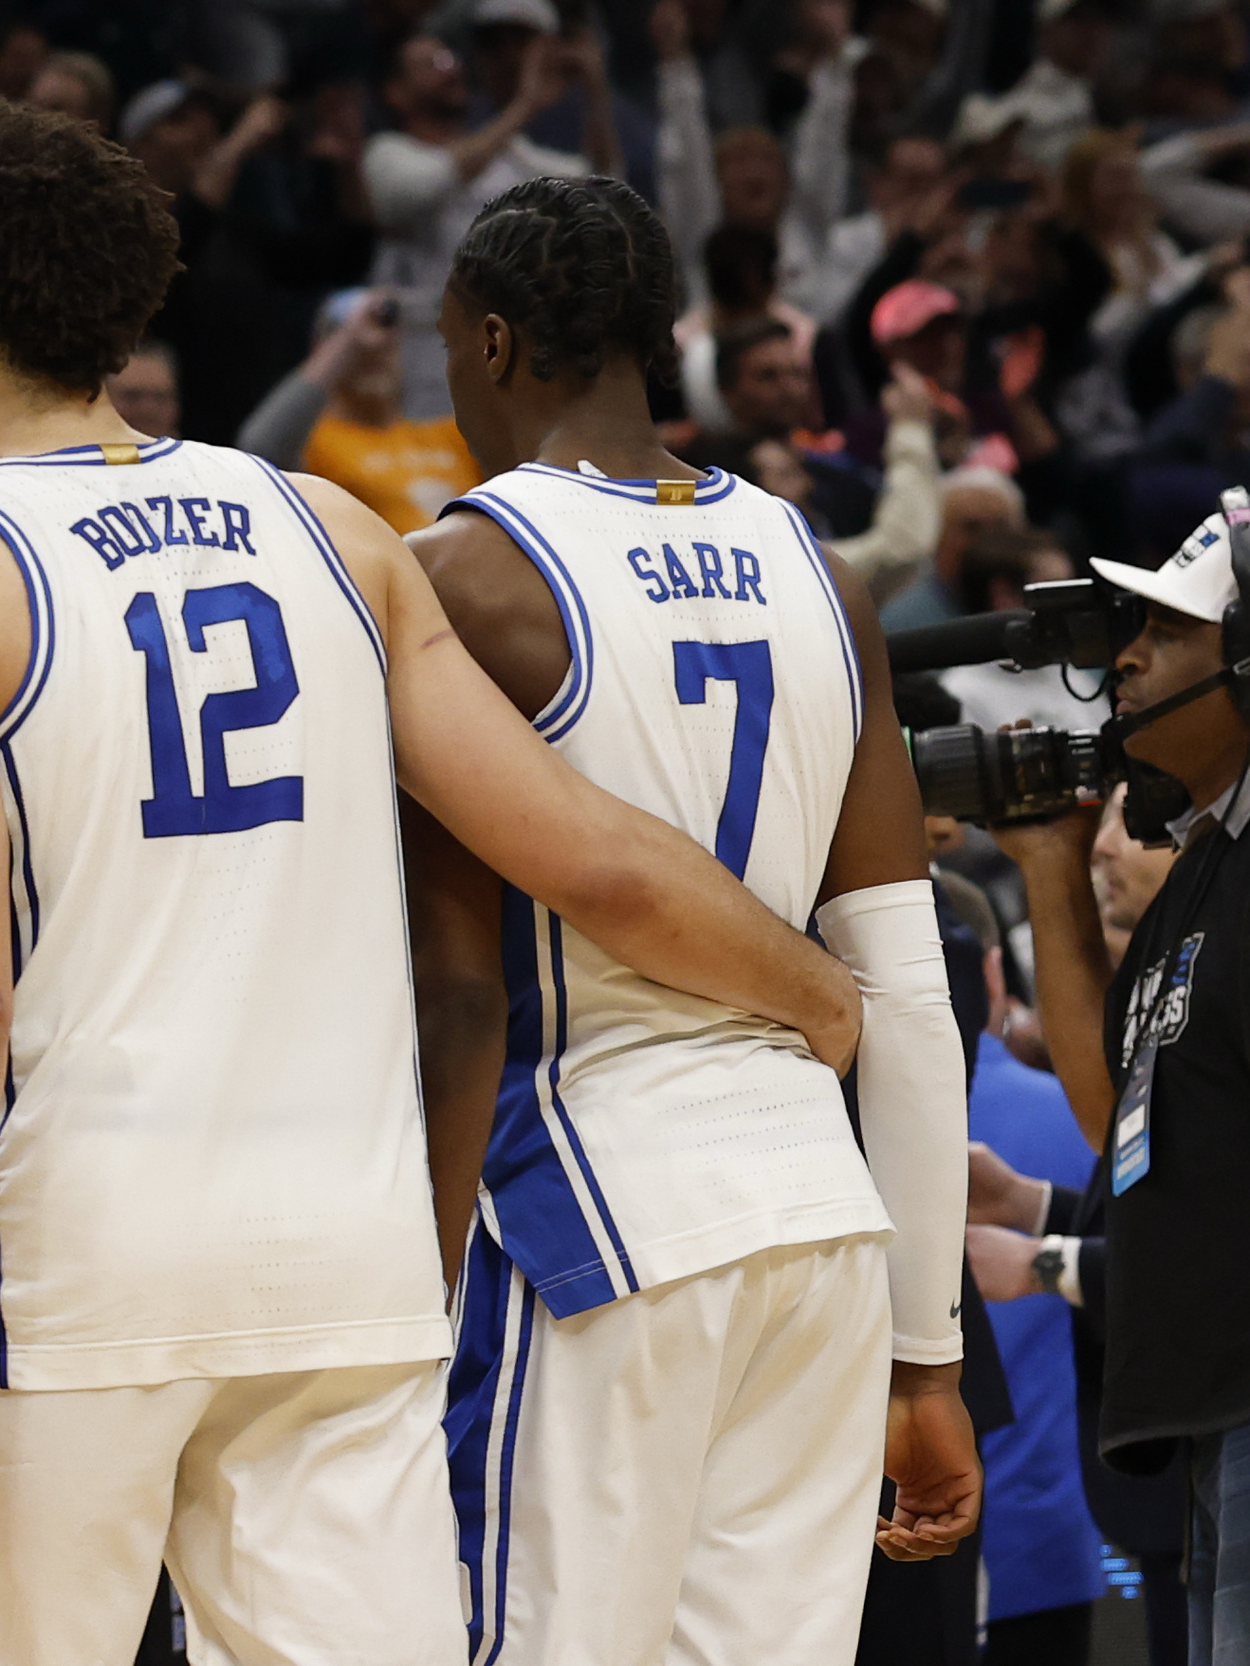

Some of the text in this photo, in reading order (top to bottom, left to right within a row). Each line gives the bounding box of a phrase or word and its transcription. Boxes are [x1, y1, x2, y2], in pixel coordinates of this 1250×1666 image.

[68, 495, 258, 572] BOOZER
[627, 541, 768, 606] SARR
[123, 580, 305, 839] 12
[671, 638, 776, 884] 7
